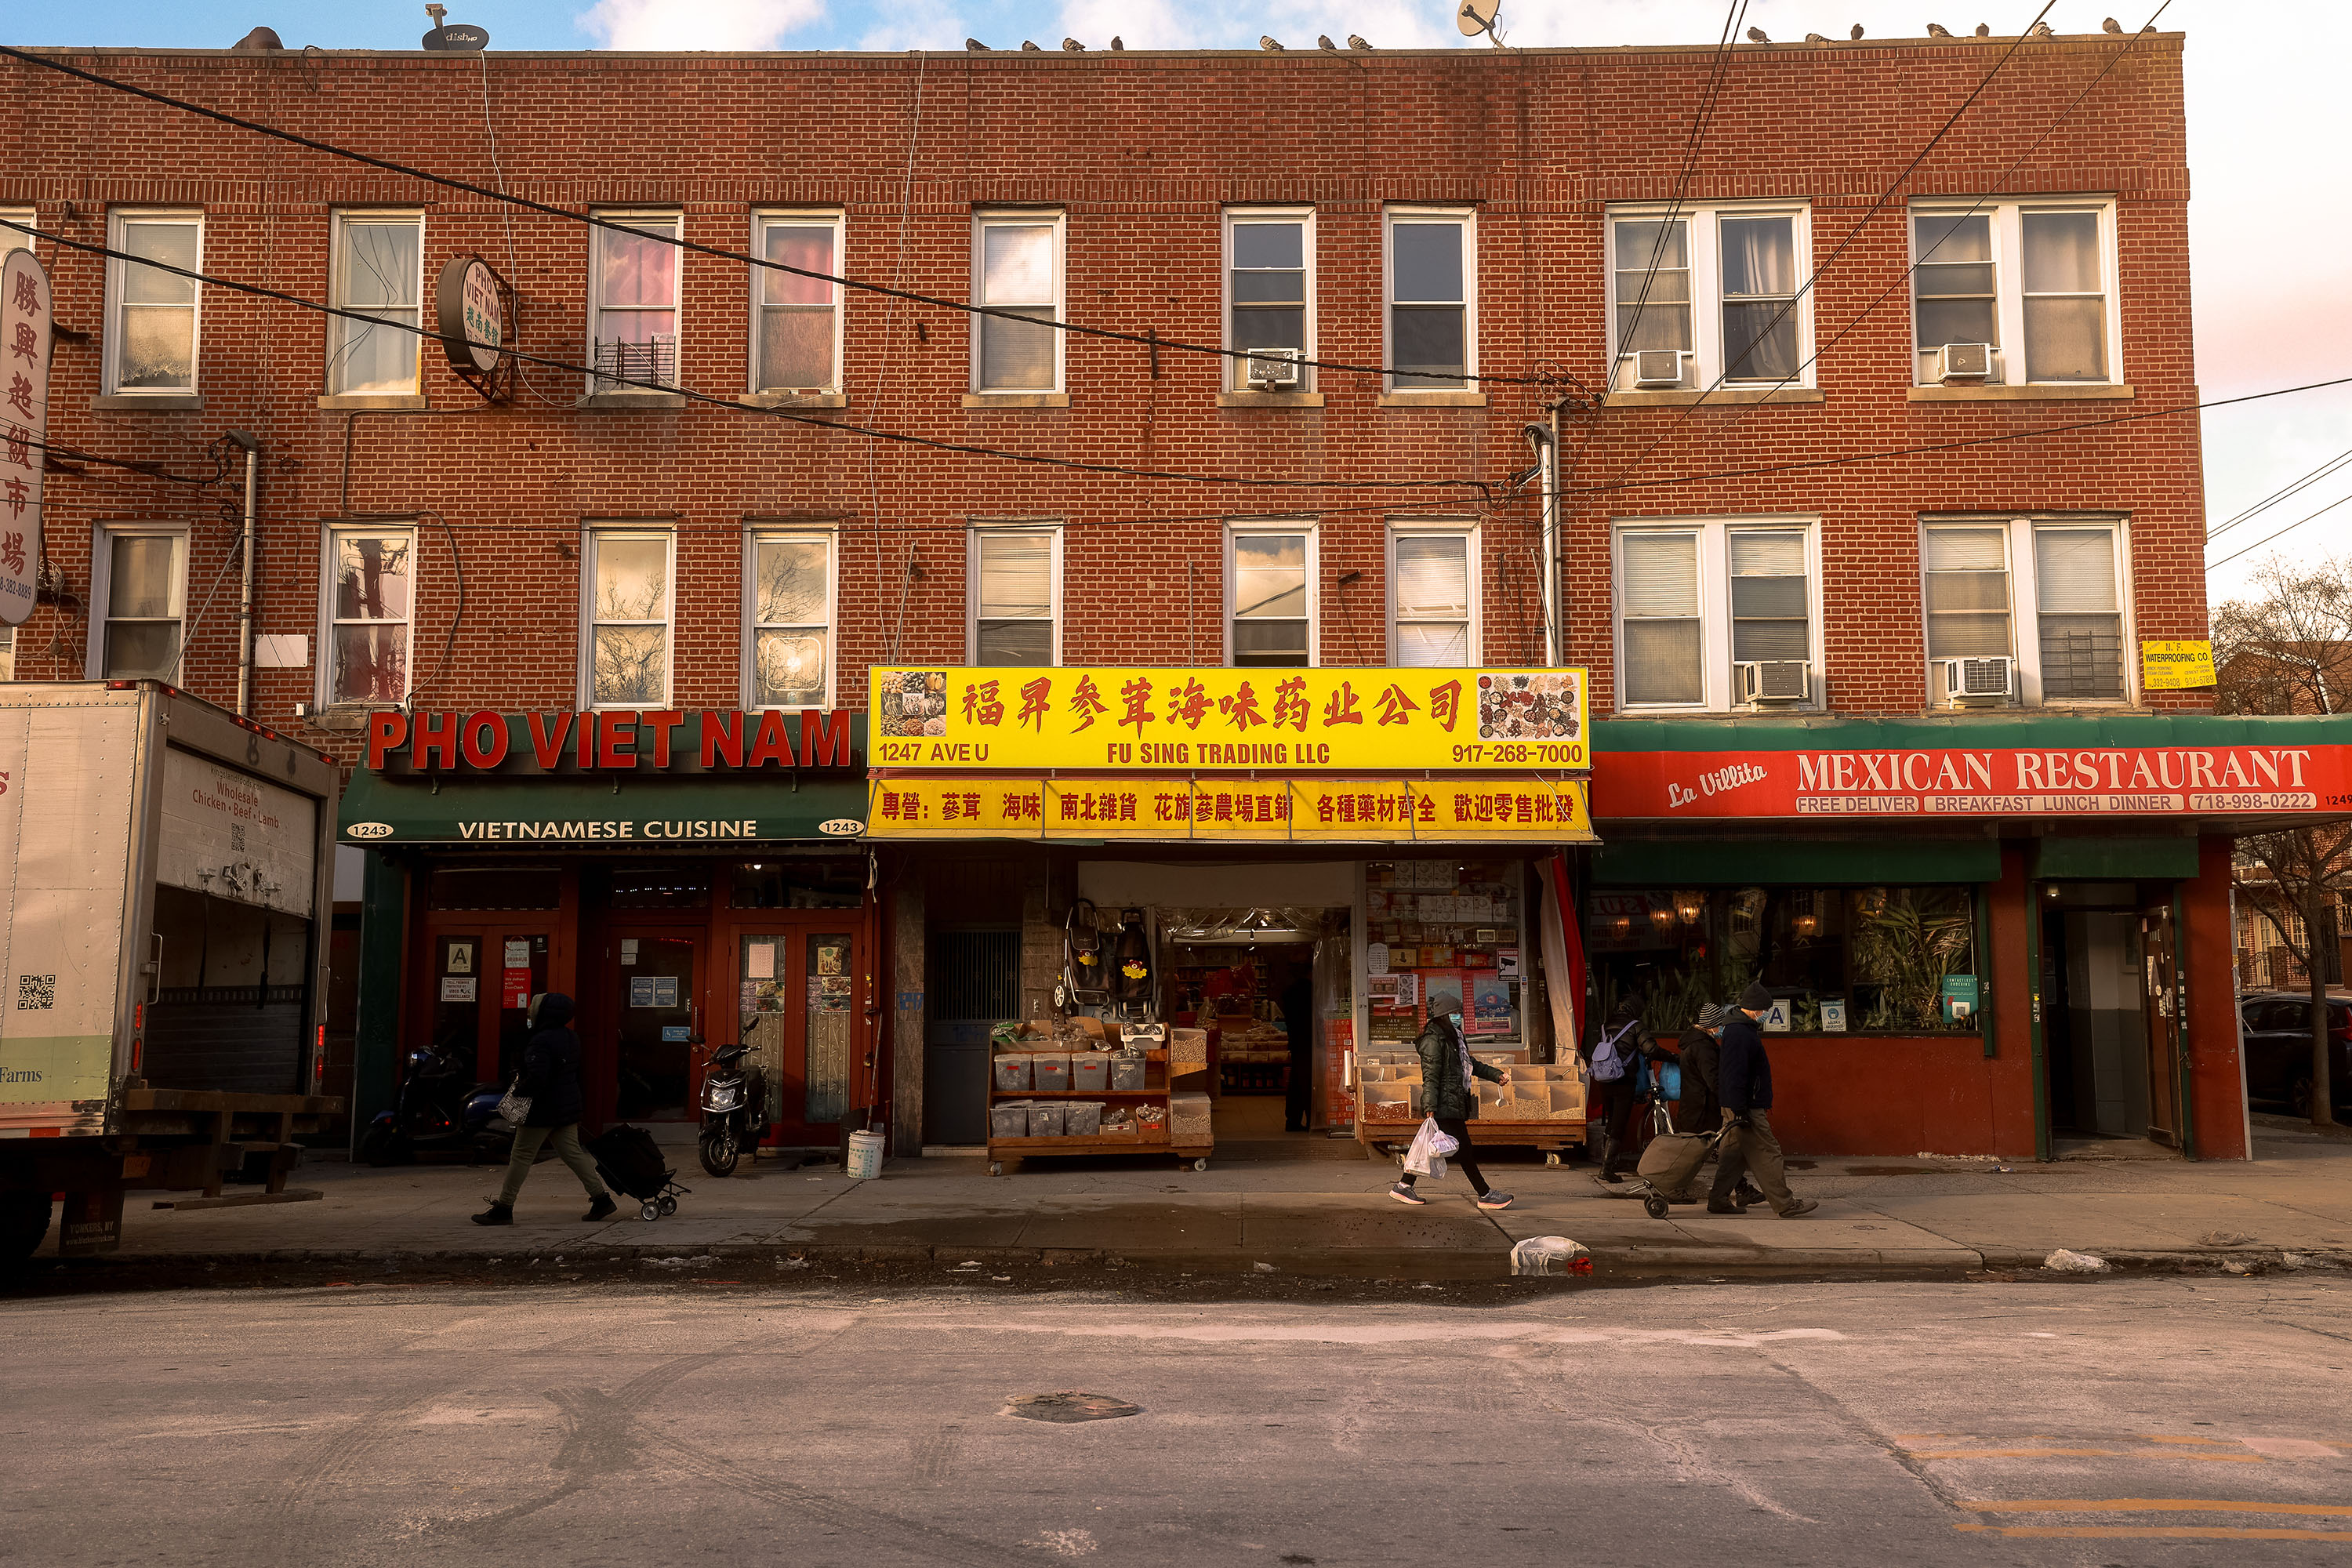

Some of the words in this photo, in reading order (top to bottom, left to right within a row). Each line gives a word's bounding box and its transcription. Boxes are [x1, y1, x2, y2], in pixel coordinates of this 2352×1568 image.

[475, 265, 492, 295] PHO
[466, 280, 484, 309] VIET
[485, 296, 499, 325] NAM
[1, 270, 42, 575] 勝興超級市場
[2145, 653, 2195, 662] WATERPROOFING
[2198, 652, 2210, 662] CO.
[368, 710, 510, 770] PHO
[527, 709, 684, 769] VIET
[700, 709, 851, 768] NAM
[879, 744, 922, 761] 1247
[931, 743, 969, 761] AVE
[975, 743, 989, 761] U
[1108, 743, 1131, 764] FU
[1140, 743, 1189, 764] SING
[1200, 743, 1287, 764] TRADING
[1295, 743, 1330, 764] LLC
[1452, 745, 1582, 763] 917-268-7000
[1796, 753, 1993, 792] MEXICAN
[2015, 750, 2310, 790] RESTAURANT
[216, 781, 259, 808] Wholesale
[1668, 782, 1697, 808] La
[1699, 762, 1768, 797] Villita
[192, 789, 227, 812] Chicken
[234, 802, 252, 820] Beef
[258, 814, 279, 829] Lamb
[1003, 793, 1040, 820] 海味
[1061, 793, 1137, 821] 南北雜貨
[1454, 793, 1573, 823] 歡迎零售批發
[1798, 797, 1840, 812] FREE
[1846, 797, 1915, 812] DELIVER
[1936, 796, 2033, 811] BREAKFAST
[2043, 796, 2100, 811] LUNCH
[2110, 796, 2172, 811] DINNER
[2194, 793, 2311, 809] 718-998-0222
[353, 825, 387, 837] 1243
[458, 821, 633, 840] VIETNAMESE
[644, 820, 757, 838] CUISINE
[825, 821, 858, 833] 1243
[452, 947, 466, 964] A
[1769, 1007, 1784, 1024] A
[0, 1067, 42, 1083] Farms
